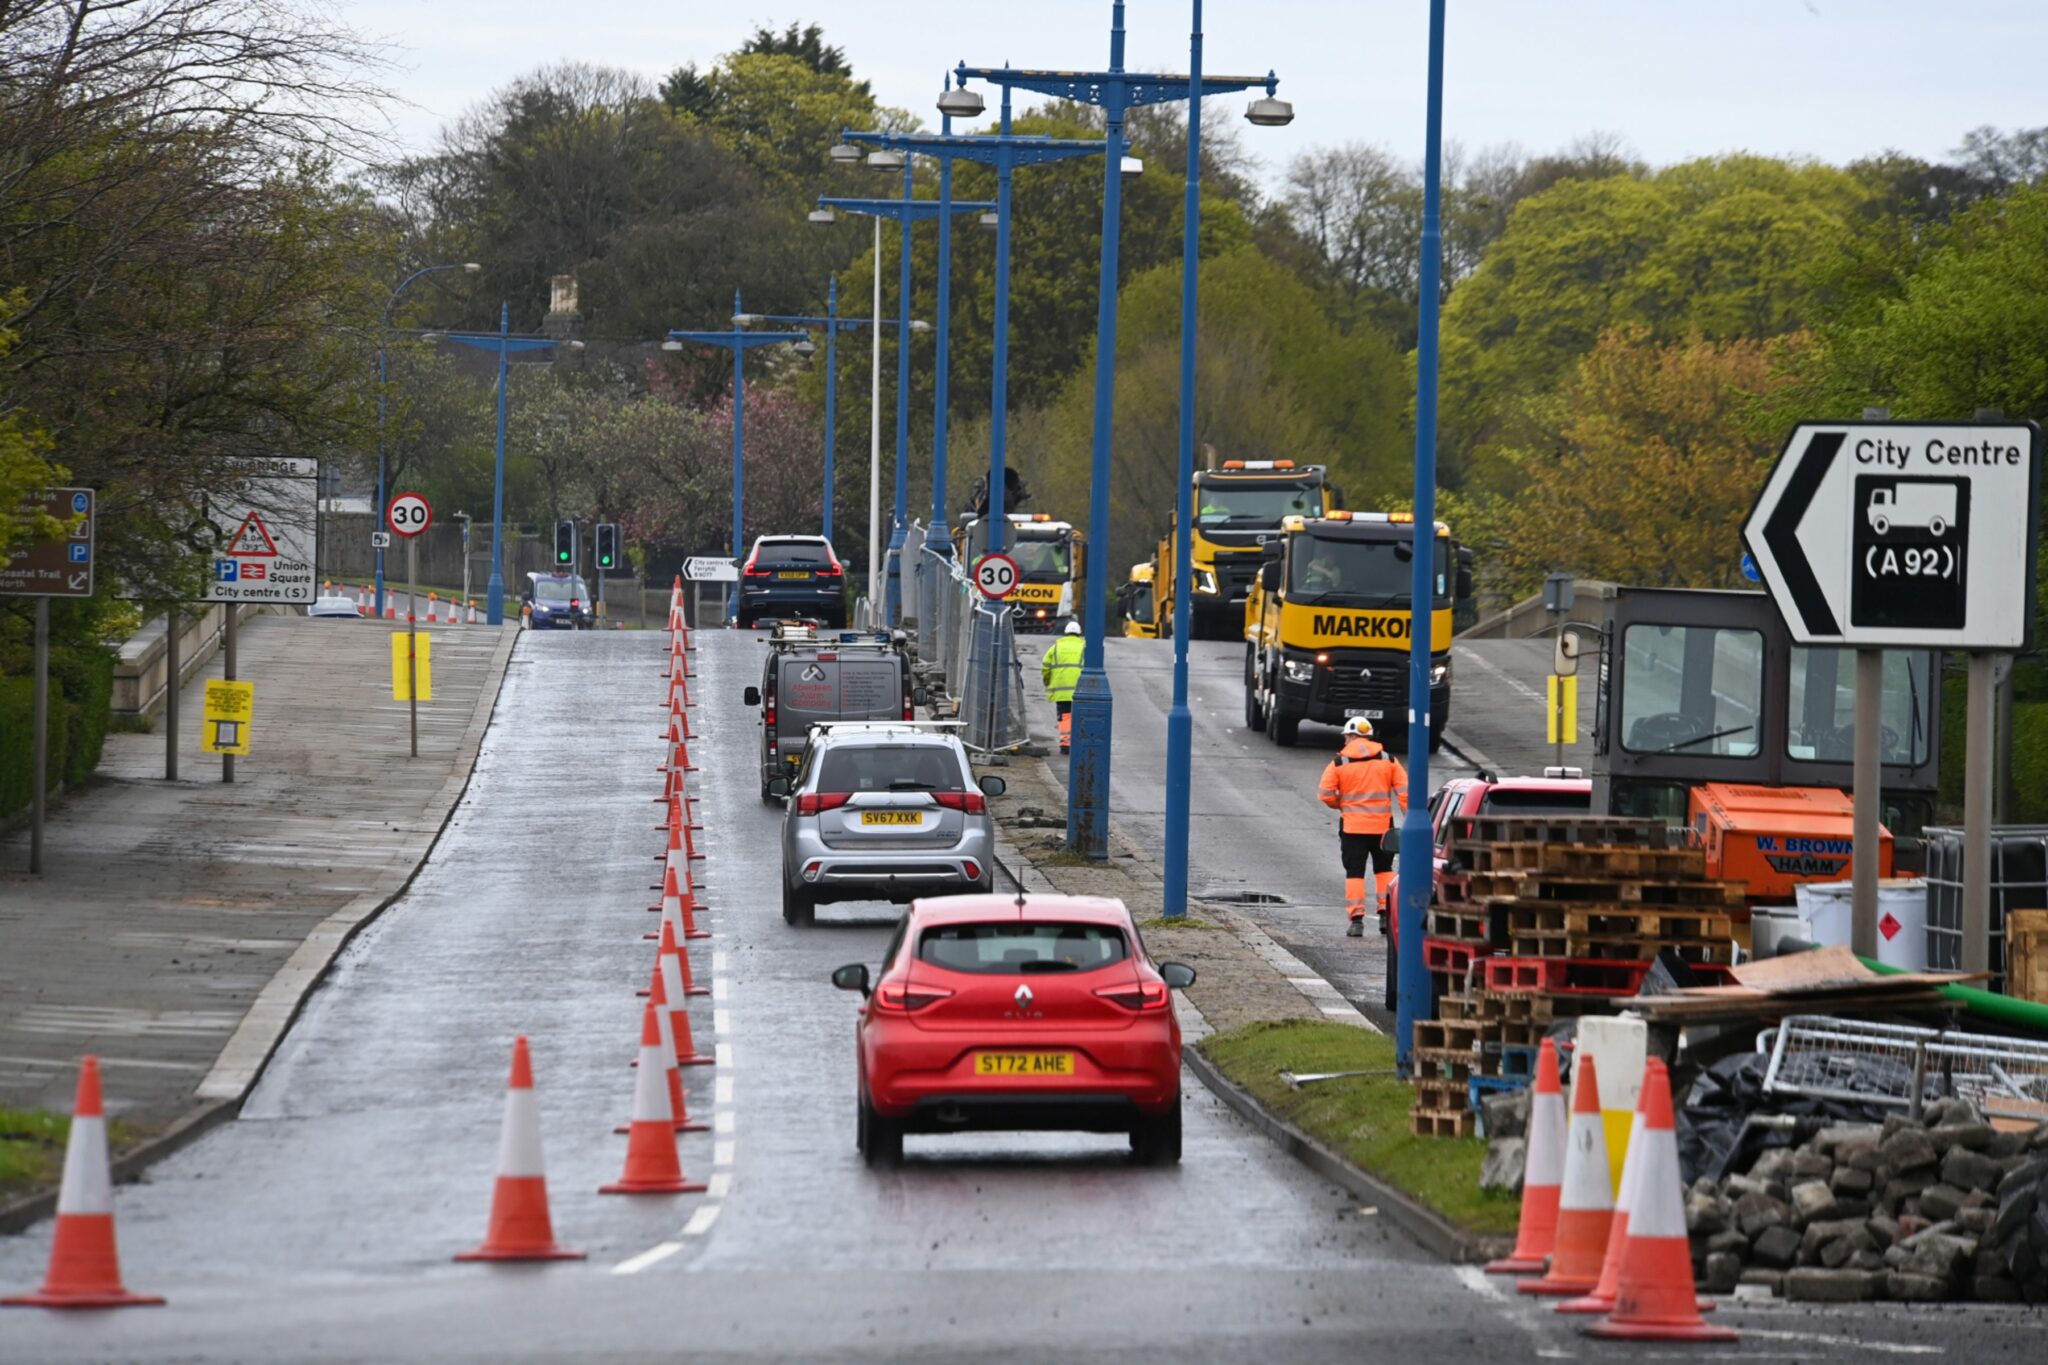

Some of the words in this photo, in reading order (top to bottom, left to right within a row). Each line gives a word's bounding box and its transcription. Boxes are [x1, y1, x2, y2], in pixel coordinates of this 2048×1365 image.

[1855, 438, 1910, 470] City
[1925, 438, 2021, 465] Centre
[393, 505, 425, 524] 30
[273, 561, 308, 571] Union
[38, 569, 61, 579] Trail
[269, 573, 311, 584] Square
[981, 567, 1013, 585] 30
[215, 587, 240, 598] City
[243, 589, 281, 598] centre
[1010, 588, 1054, 598] RKON
[865, 812, 894, 823] SV67
[896, 812, 918, 823] XXK
[1756, 836, 1778, 851] W.
[1780, 857, 1834, 873] HAMM
[982, 1055, 1027, 1072] ST72
[1033, 1055, 1066, 1072] AHE
